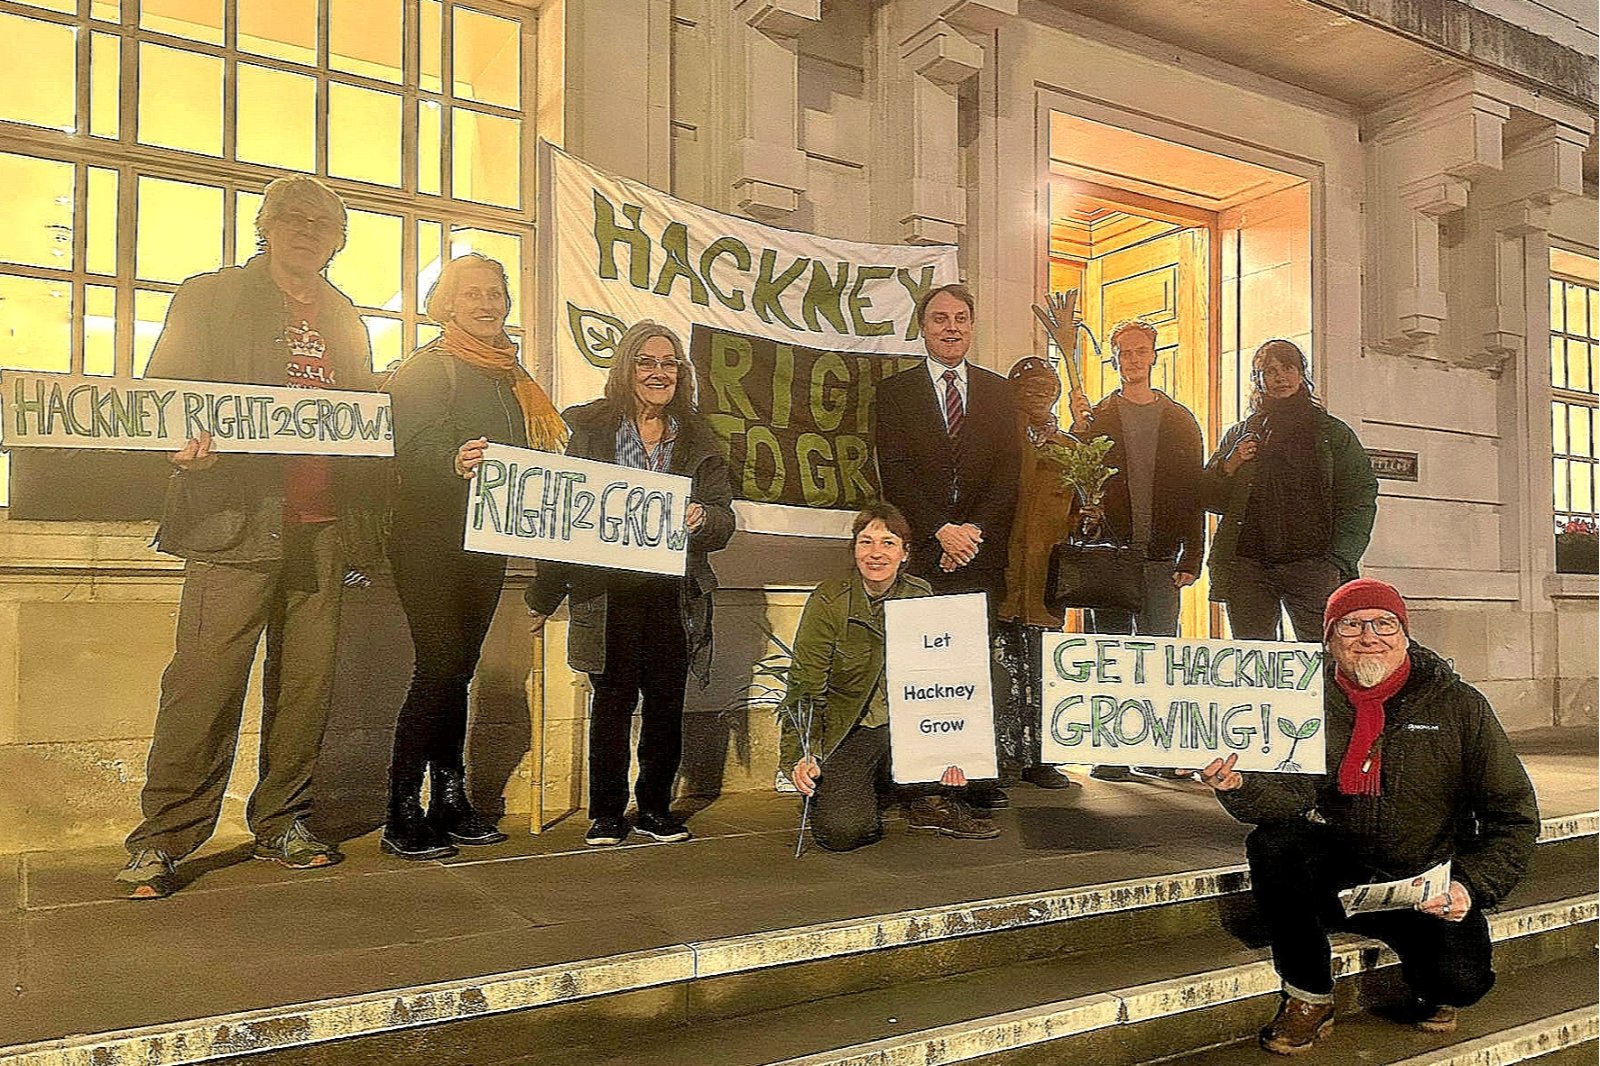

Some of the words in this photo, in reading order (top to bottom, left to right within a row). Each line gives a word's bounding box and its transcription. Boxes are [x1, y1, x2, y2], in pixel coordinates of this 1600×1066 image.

[592, 188, 935, 341] HACKNEY
[13, 377, 176, 438] HACKNEY
[923, 632, 951, 649] Let
[1053, 638, 1156, 684] GET
[1164, 645, 1322, 690] HACKNEY
[904, 683, 975, 702] Hackney
[919, 718, 965, 734] Grow
[1050, 694, 1272, 754] GROWING!
